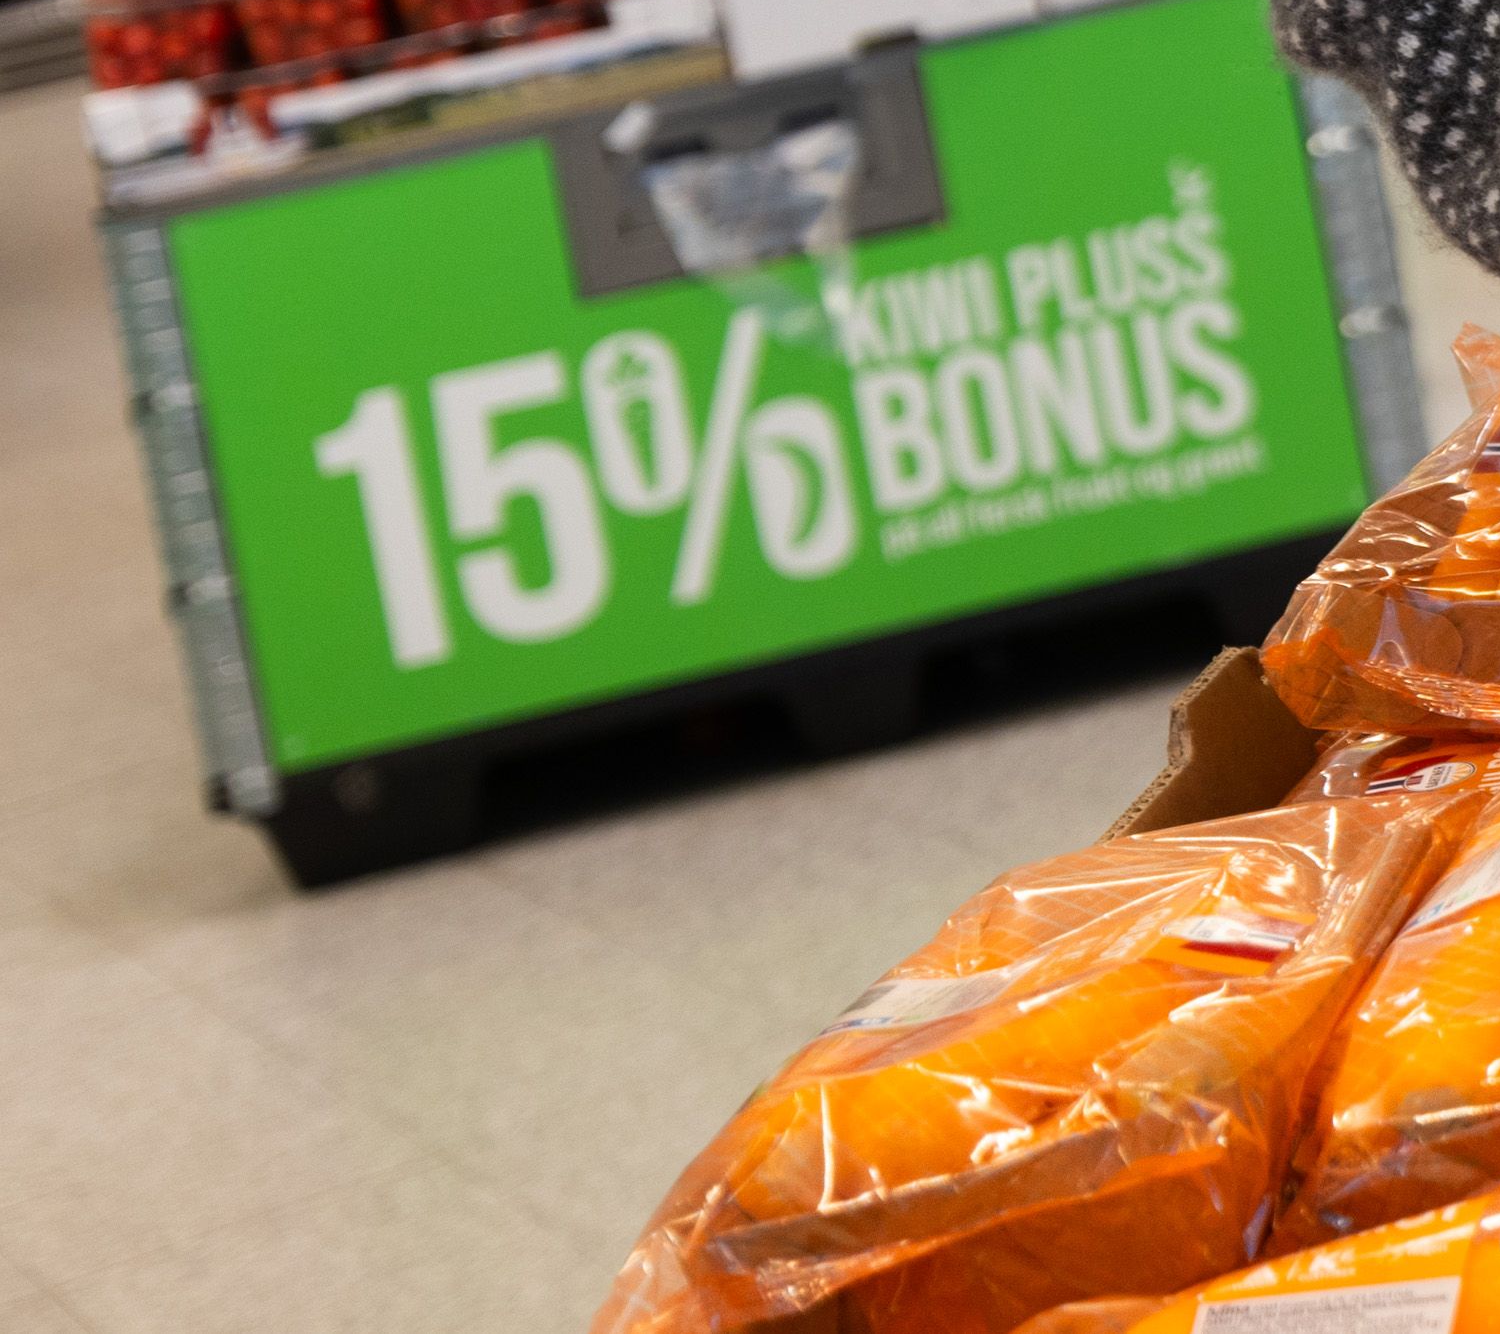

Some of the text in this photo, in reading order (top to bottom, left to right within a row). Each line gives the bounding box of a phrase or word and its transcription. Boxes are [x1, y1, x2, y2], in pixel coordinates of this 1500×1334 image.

[838, 211, 1230, 368] KIWI PLUSS
[313, 304, 862, 672] 15%
[852, 298, 1253, 516] BONUS
